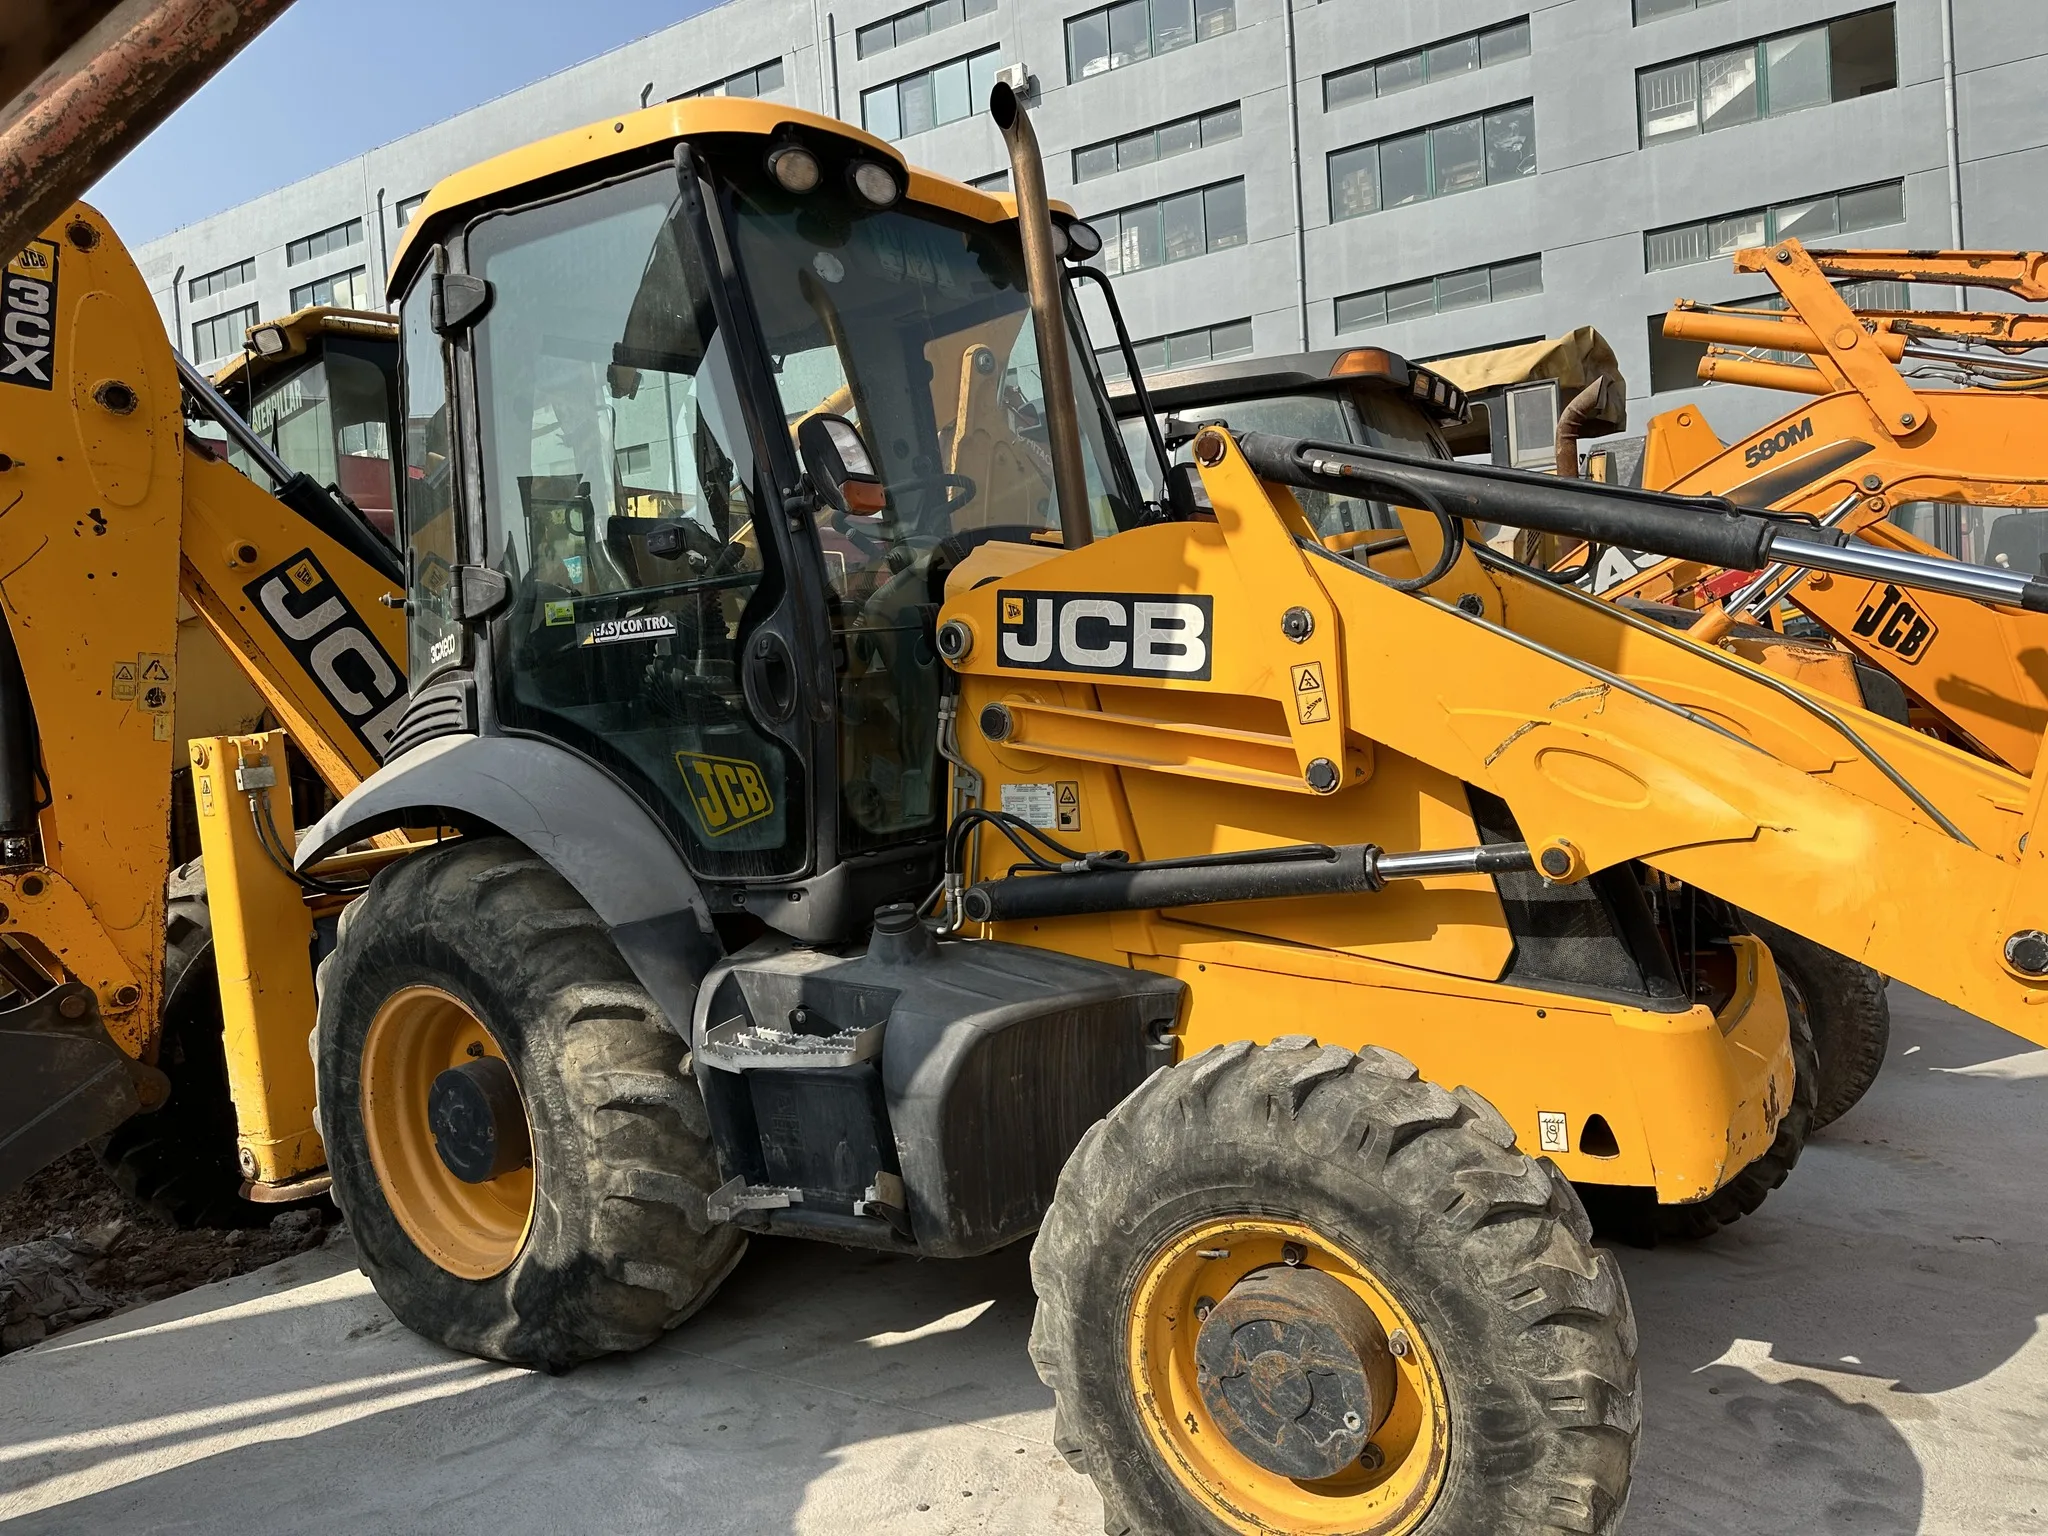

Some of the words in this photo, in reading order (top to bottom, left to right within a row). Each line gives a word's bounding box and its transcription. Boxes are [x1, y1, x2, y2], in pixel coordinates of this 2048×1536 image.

[21, 248, 46, 267] JCB
[0, 279, 50, 382] 3CX
[252, 379, 302, 432] ATERPILLAR
[1745, 417, 1814, 468] 580M
[297, 565, 313, 586] JCB
[1003, 598, 1206, 672] JCB
[1852, 584, 1930, 656] JCB
[692, 760, 767, 827] JCB
